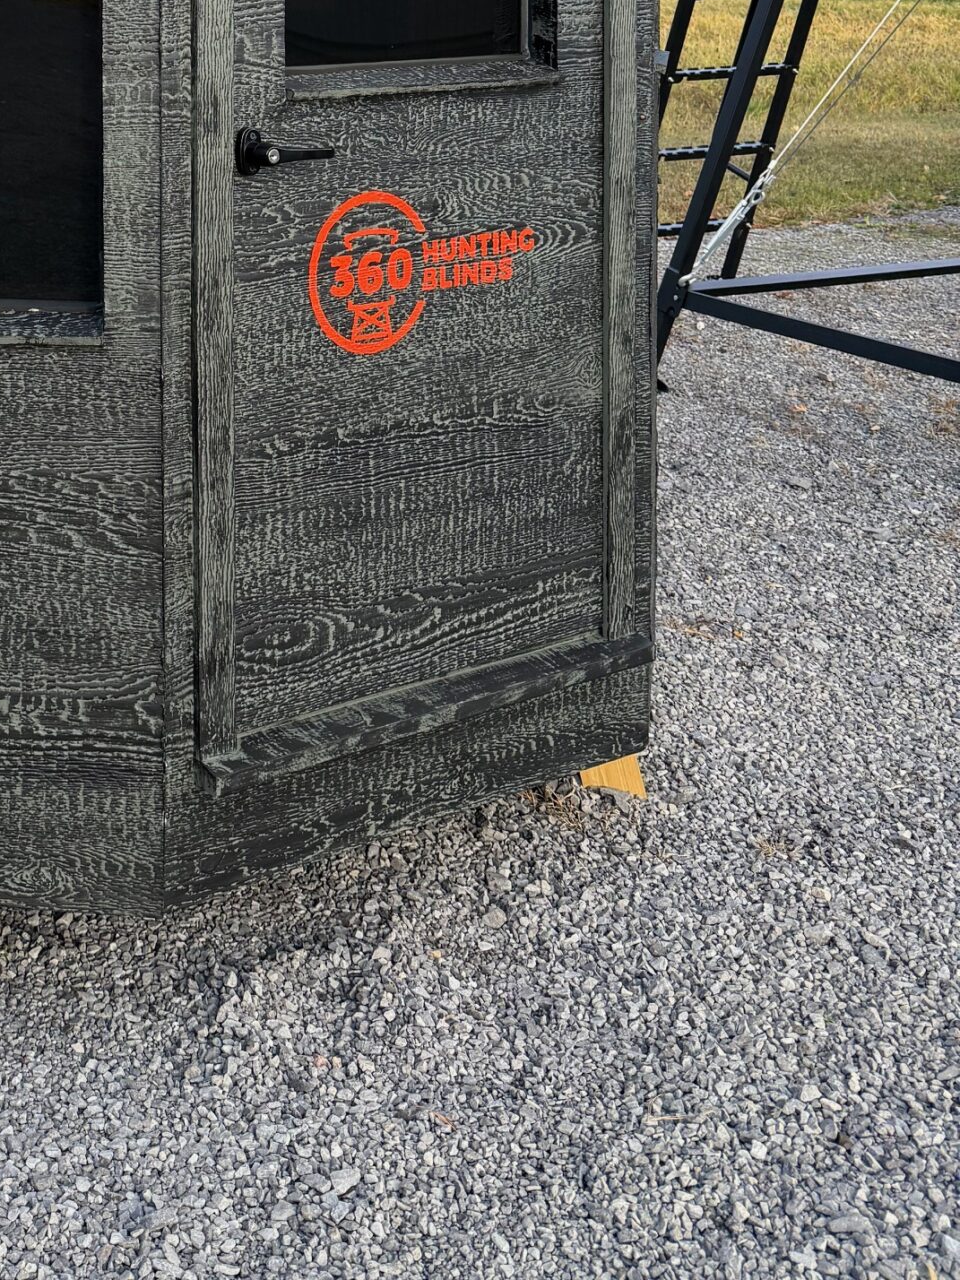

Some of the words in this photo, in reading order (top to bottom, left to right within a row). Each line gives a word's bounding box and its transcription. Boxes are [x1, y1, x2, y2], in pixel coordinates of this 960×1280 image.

[422, 227, 535, 263] HUNTING
[329, 248, 413, 298] 360
[421, 257, 513, 291] BLINDS
